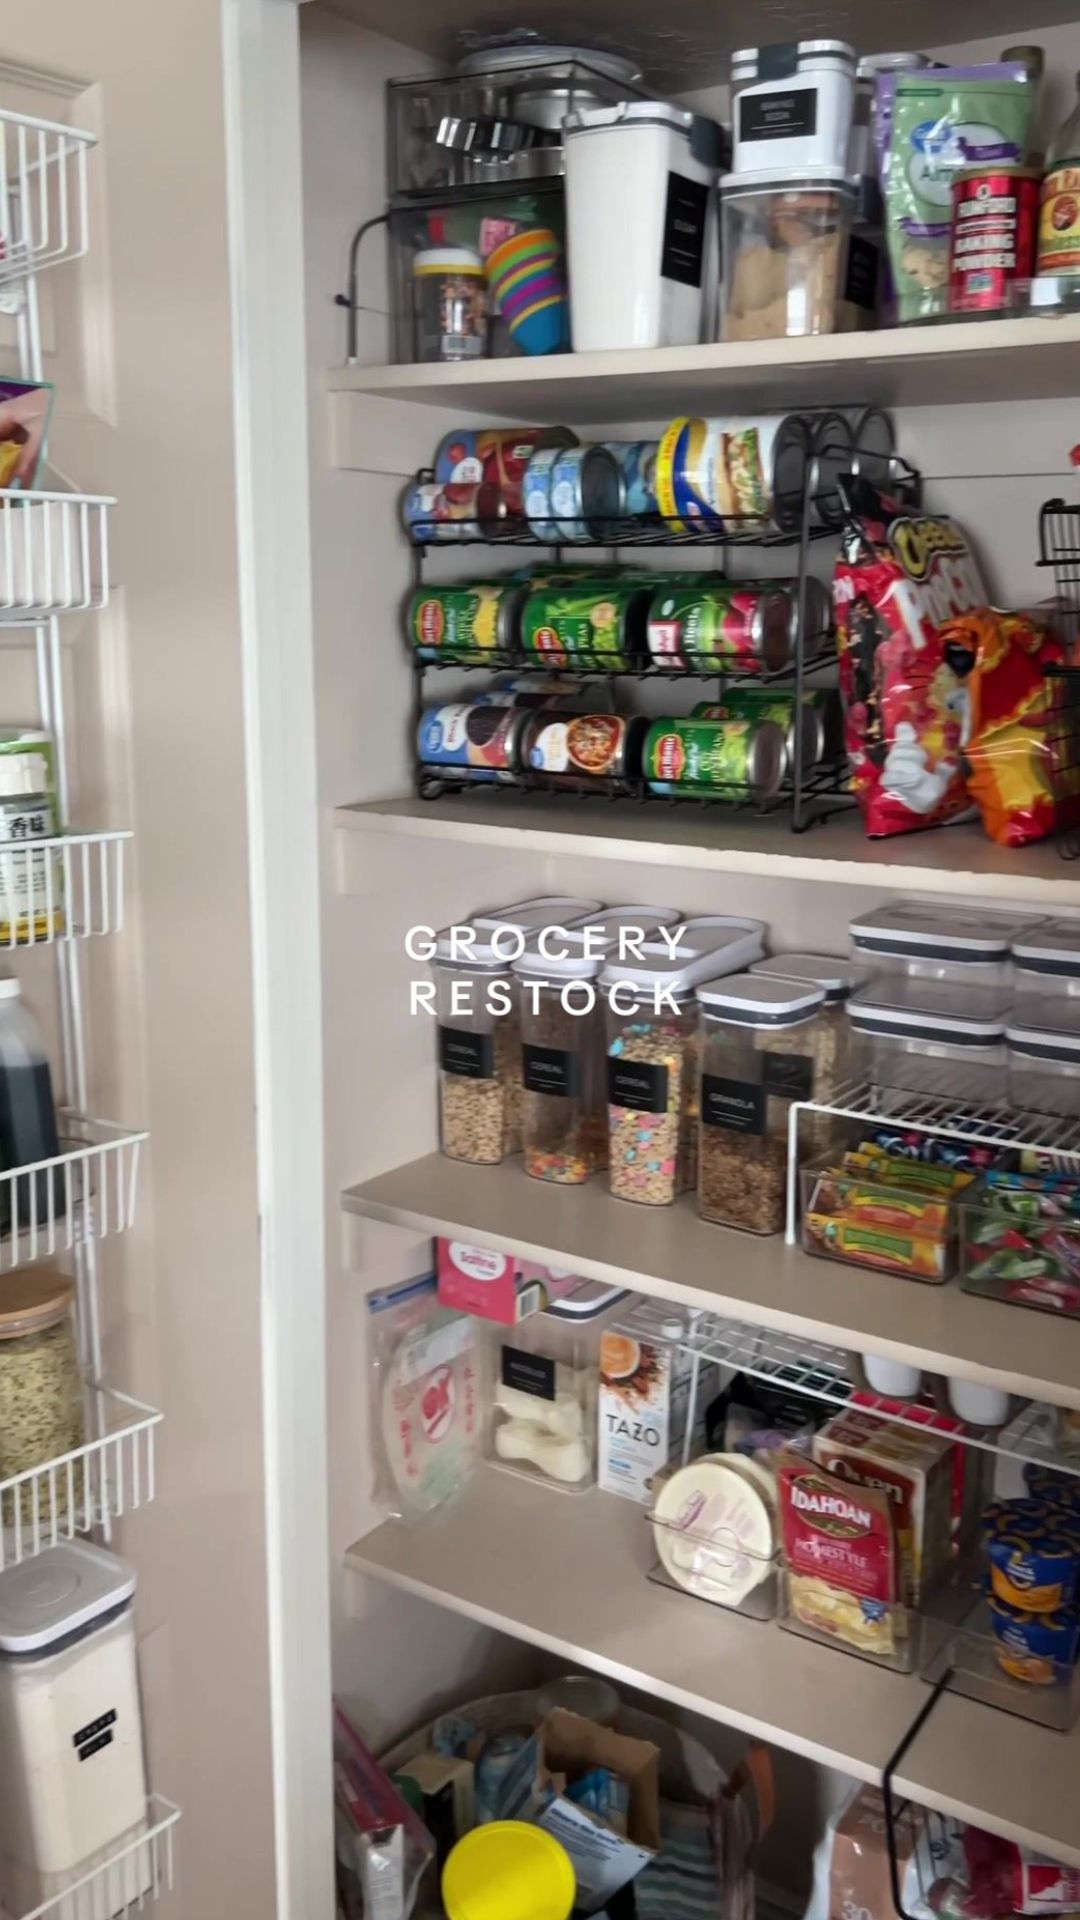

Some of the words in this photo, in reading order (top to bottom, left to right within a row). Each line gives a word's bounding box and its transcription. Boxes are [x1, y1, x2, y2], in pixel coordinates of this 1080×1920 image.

[615, 1075, 650, 1089] CEREAL
[709, 1092, 755, 1110] GRANOLA
[606, 1413, 661, 1446] TAZO
[791, 1485, 871, 1529] IDAHOAN
